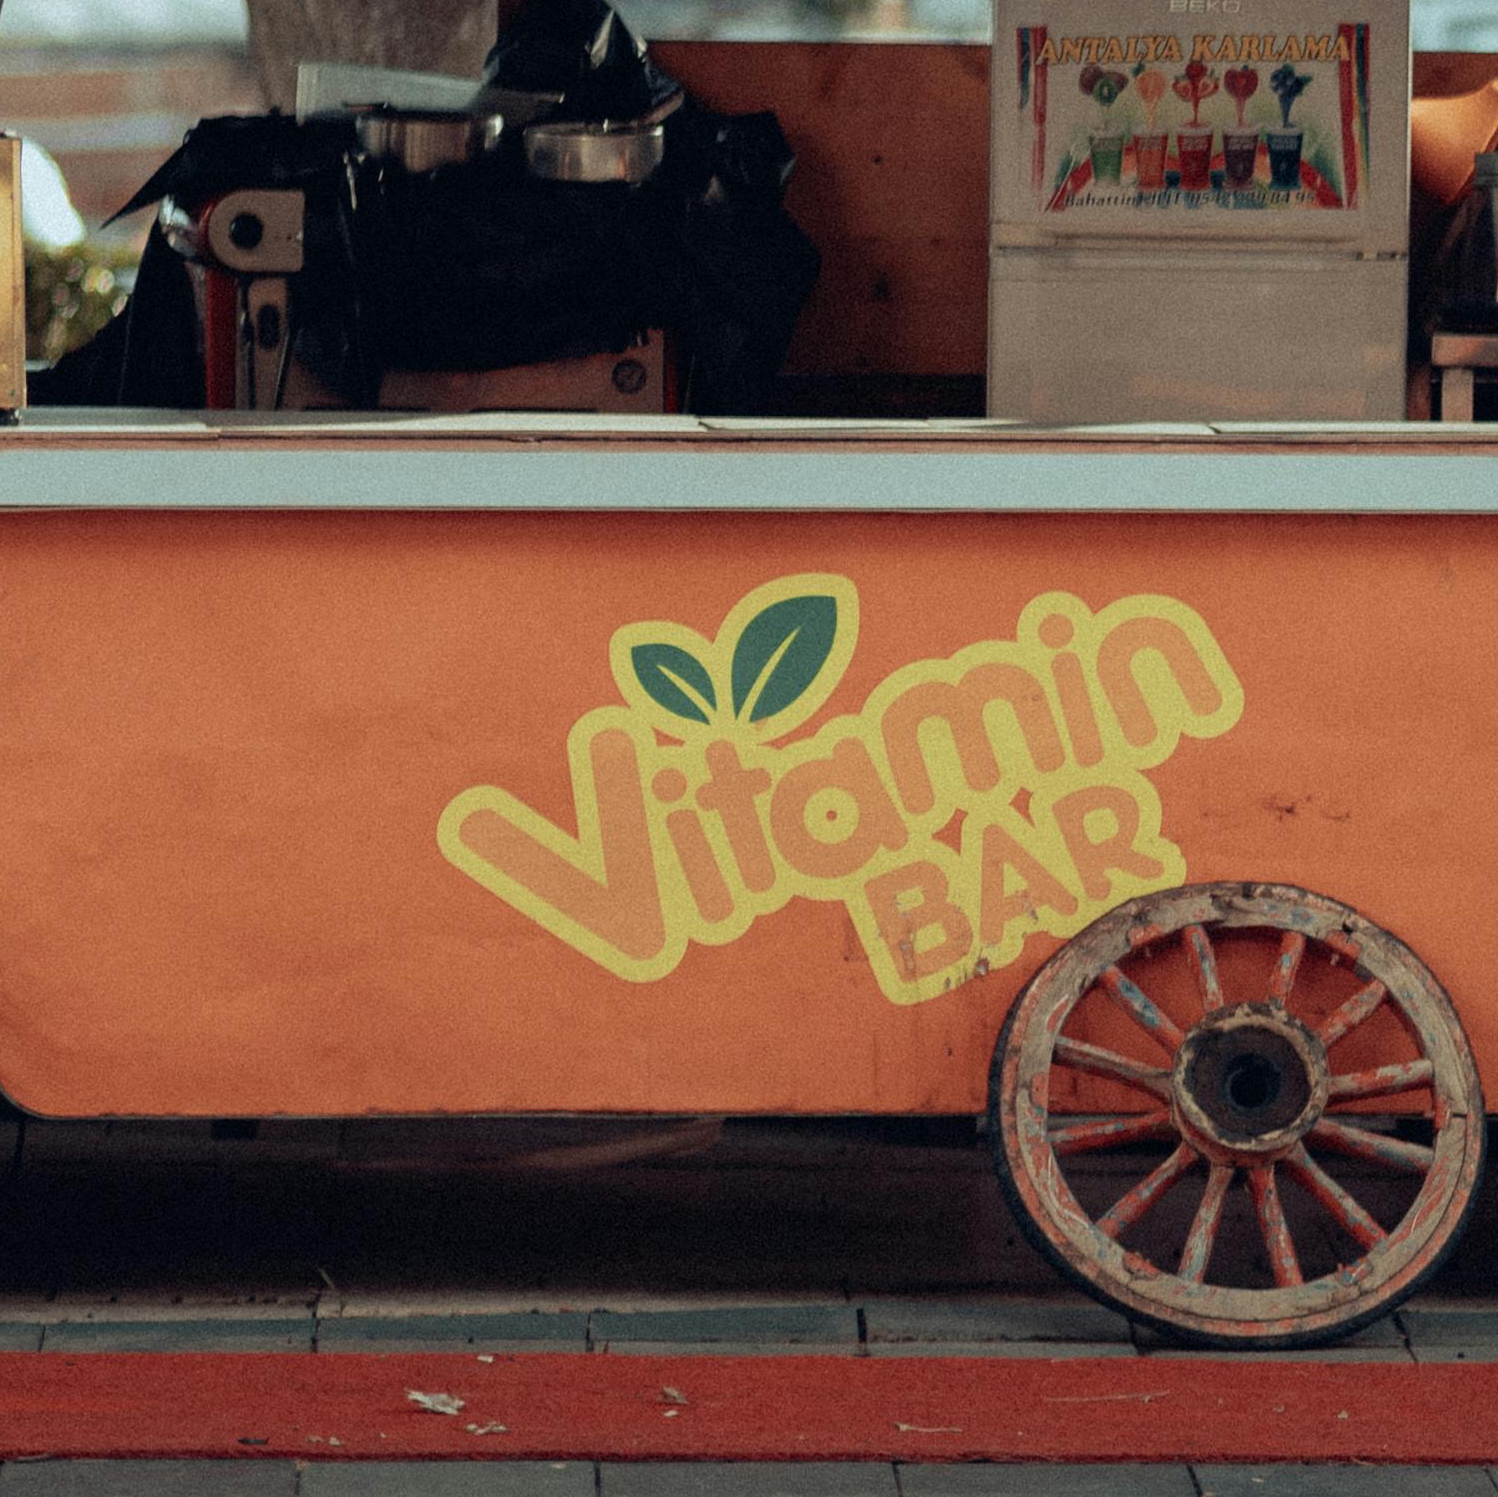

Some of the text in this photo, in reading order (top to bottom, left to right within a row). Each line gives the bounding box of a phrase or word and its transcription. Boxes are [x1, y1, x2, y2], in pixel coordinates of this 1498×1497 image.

[1037, 34, 1352, 65] ANTALYA KARLAMA
[443, 598, 1238, 977] Vitamin
[853, 778, 1176, 994] BAR
